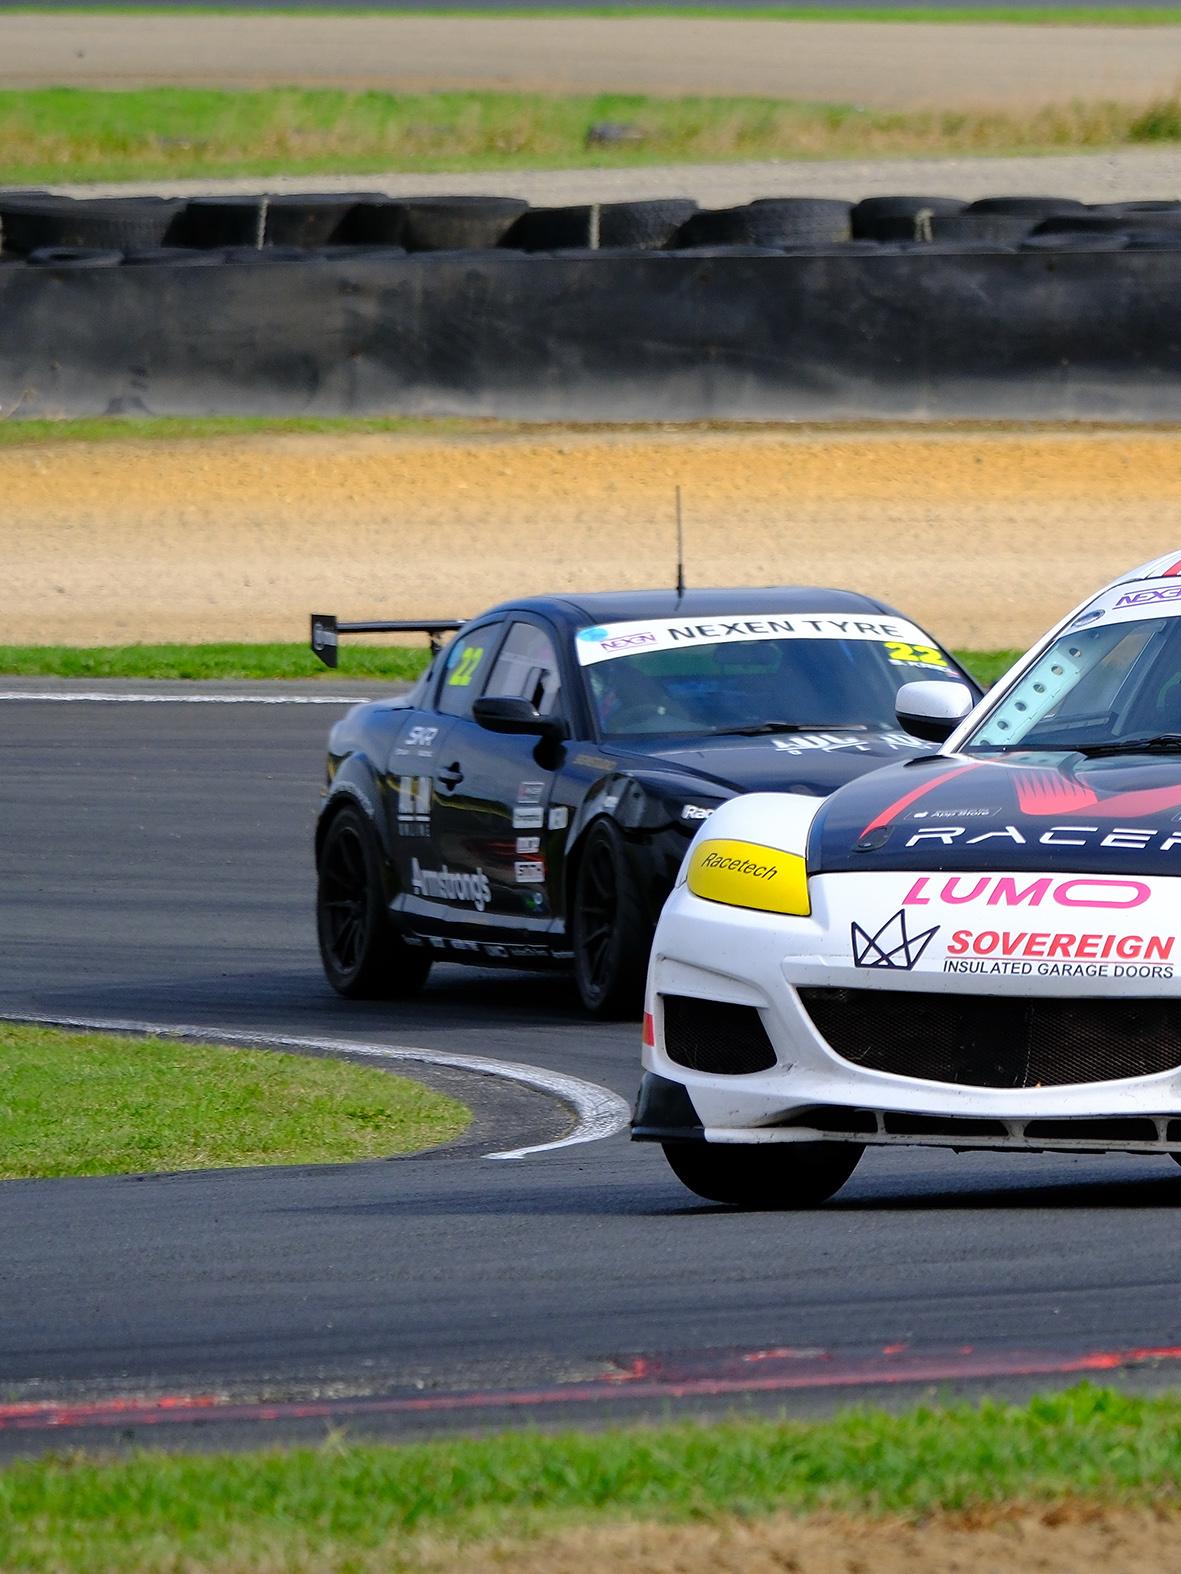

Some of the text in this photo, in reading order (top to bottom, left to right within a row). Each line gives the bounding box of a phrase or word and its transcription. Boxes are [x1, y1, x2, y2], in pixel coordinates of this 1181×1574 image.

[667, 619, 904, 641] NEXEN TYRE
[449, 647, 484, 686] 22
[884, 641, 949, 667] 22
[701, 852, 778, 881] Racetech
[902, 876, 1152, 909] LUMO
[946, 929, 1176, 960] SOVEREIGN
[943, 960, 1175, 979] INSULATED GARAGE DOORS
